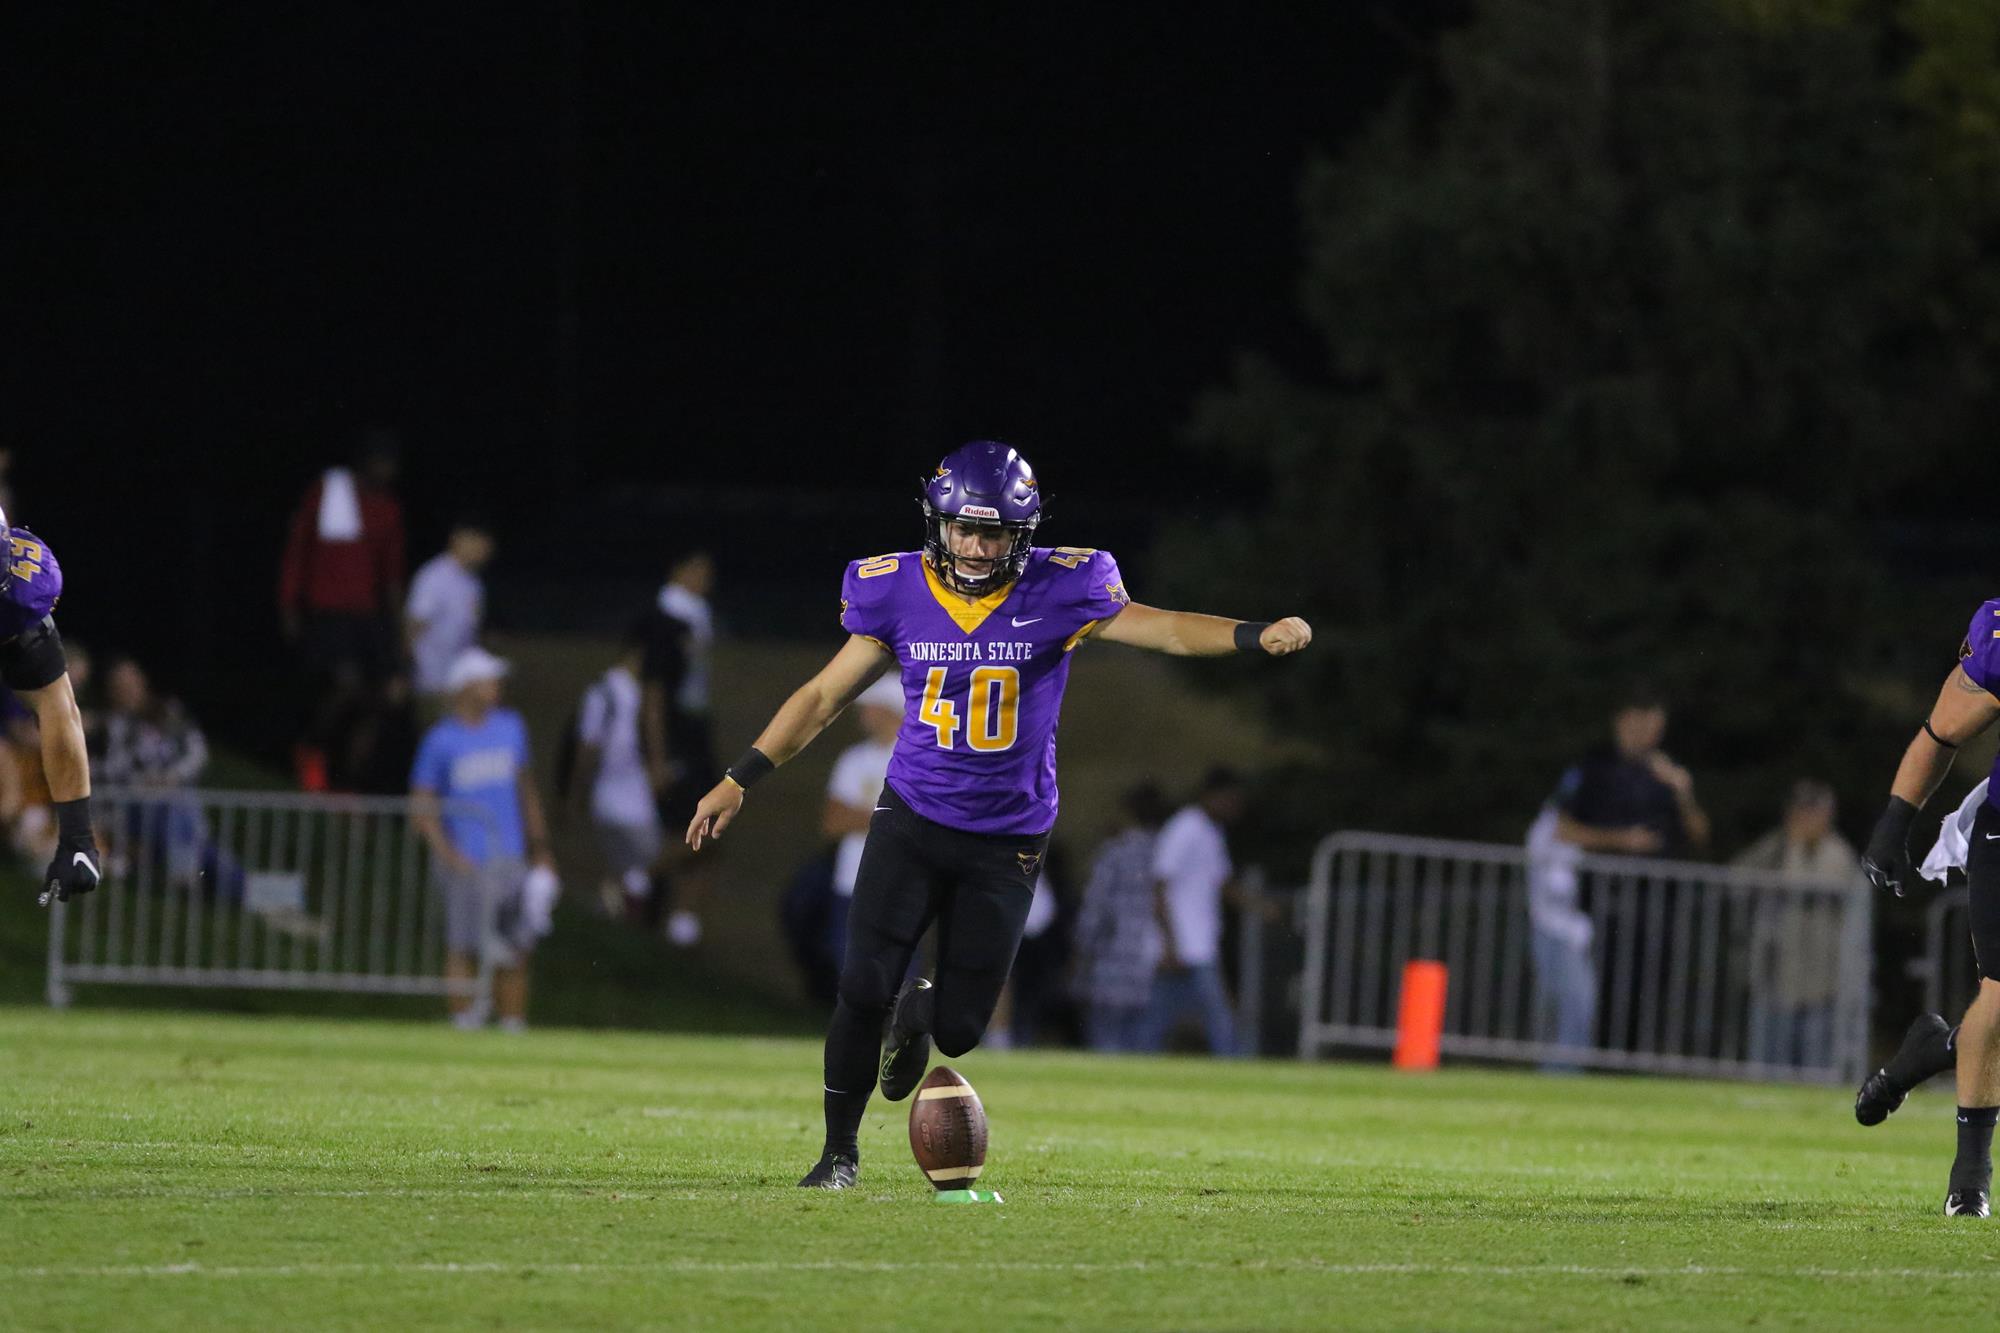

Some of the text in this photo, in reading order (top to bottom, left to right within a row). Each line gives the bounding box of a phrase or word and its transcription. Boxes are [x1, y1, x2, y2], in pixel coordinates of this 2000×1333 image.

[964, 506, 995, 517] Riddell
[908, 641, 1033, 661] MINNESOTA STATE
[918, 665, 1020, 752] 40
